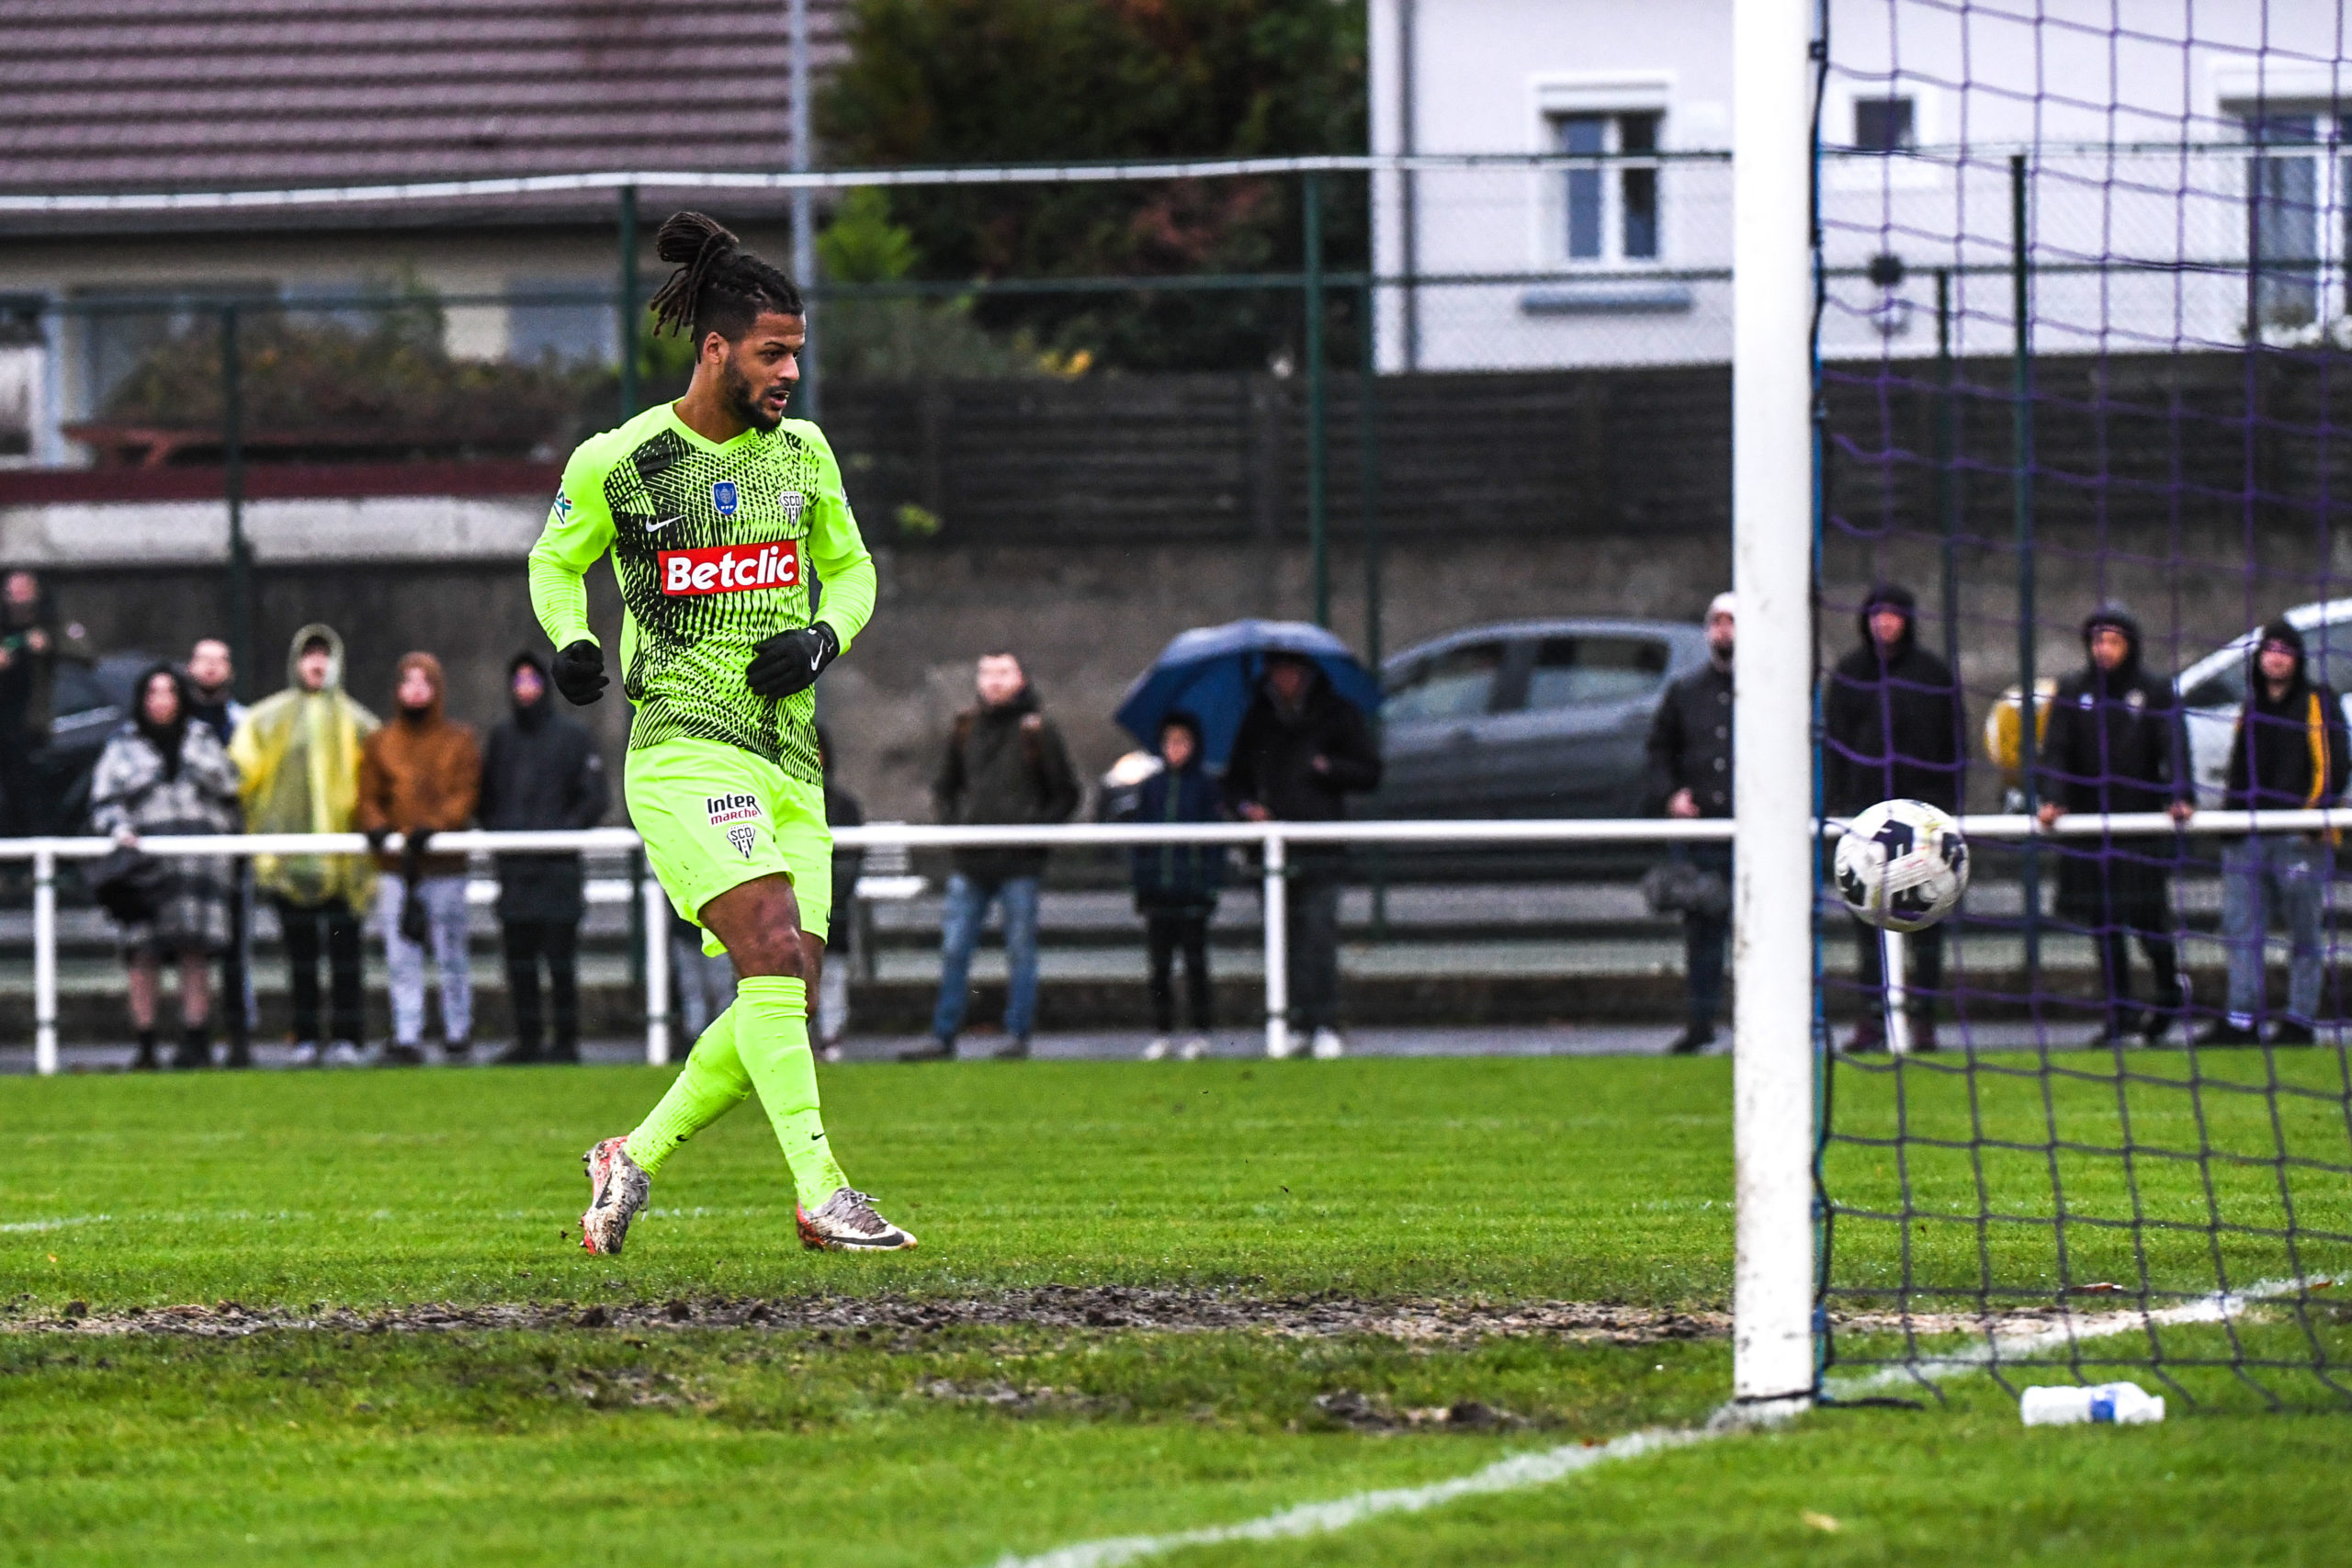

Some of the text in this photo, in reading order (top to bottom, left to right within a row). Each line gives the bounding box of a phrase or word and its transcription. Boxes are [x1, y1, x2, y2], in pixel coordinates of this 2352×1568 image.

[783, 495, 800, 506] SCO
[666, 545, 795, 591] Betclic
[729, 827, 752, 841] SCO
